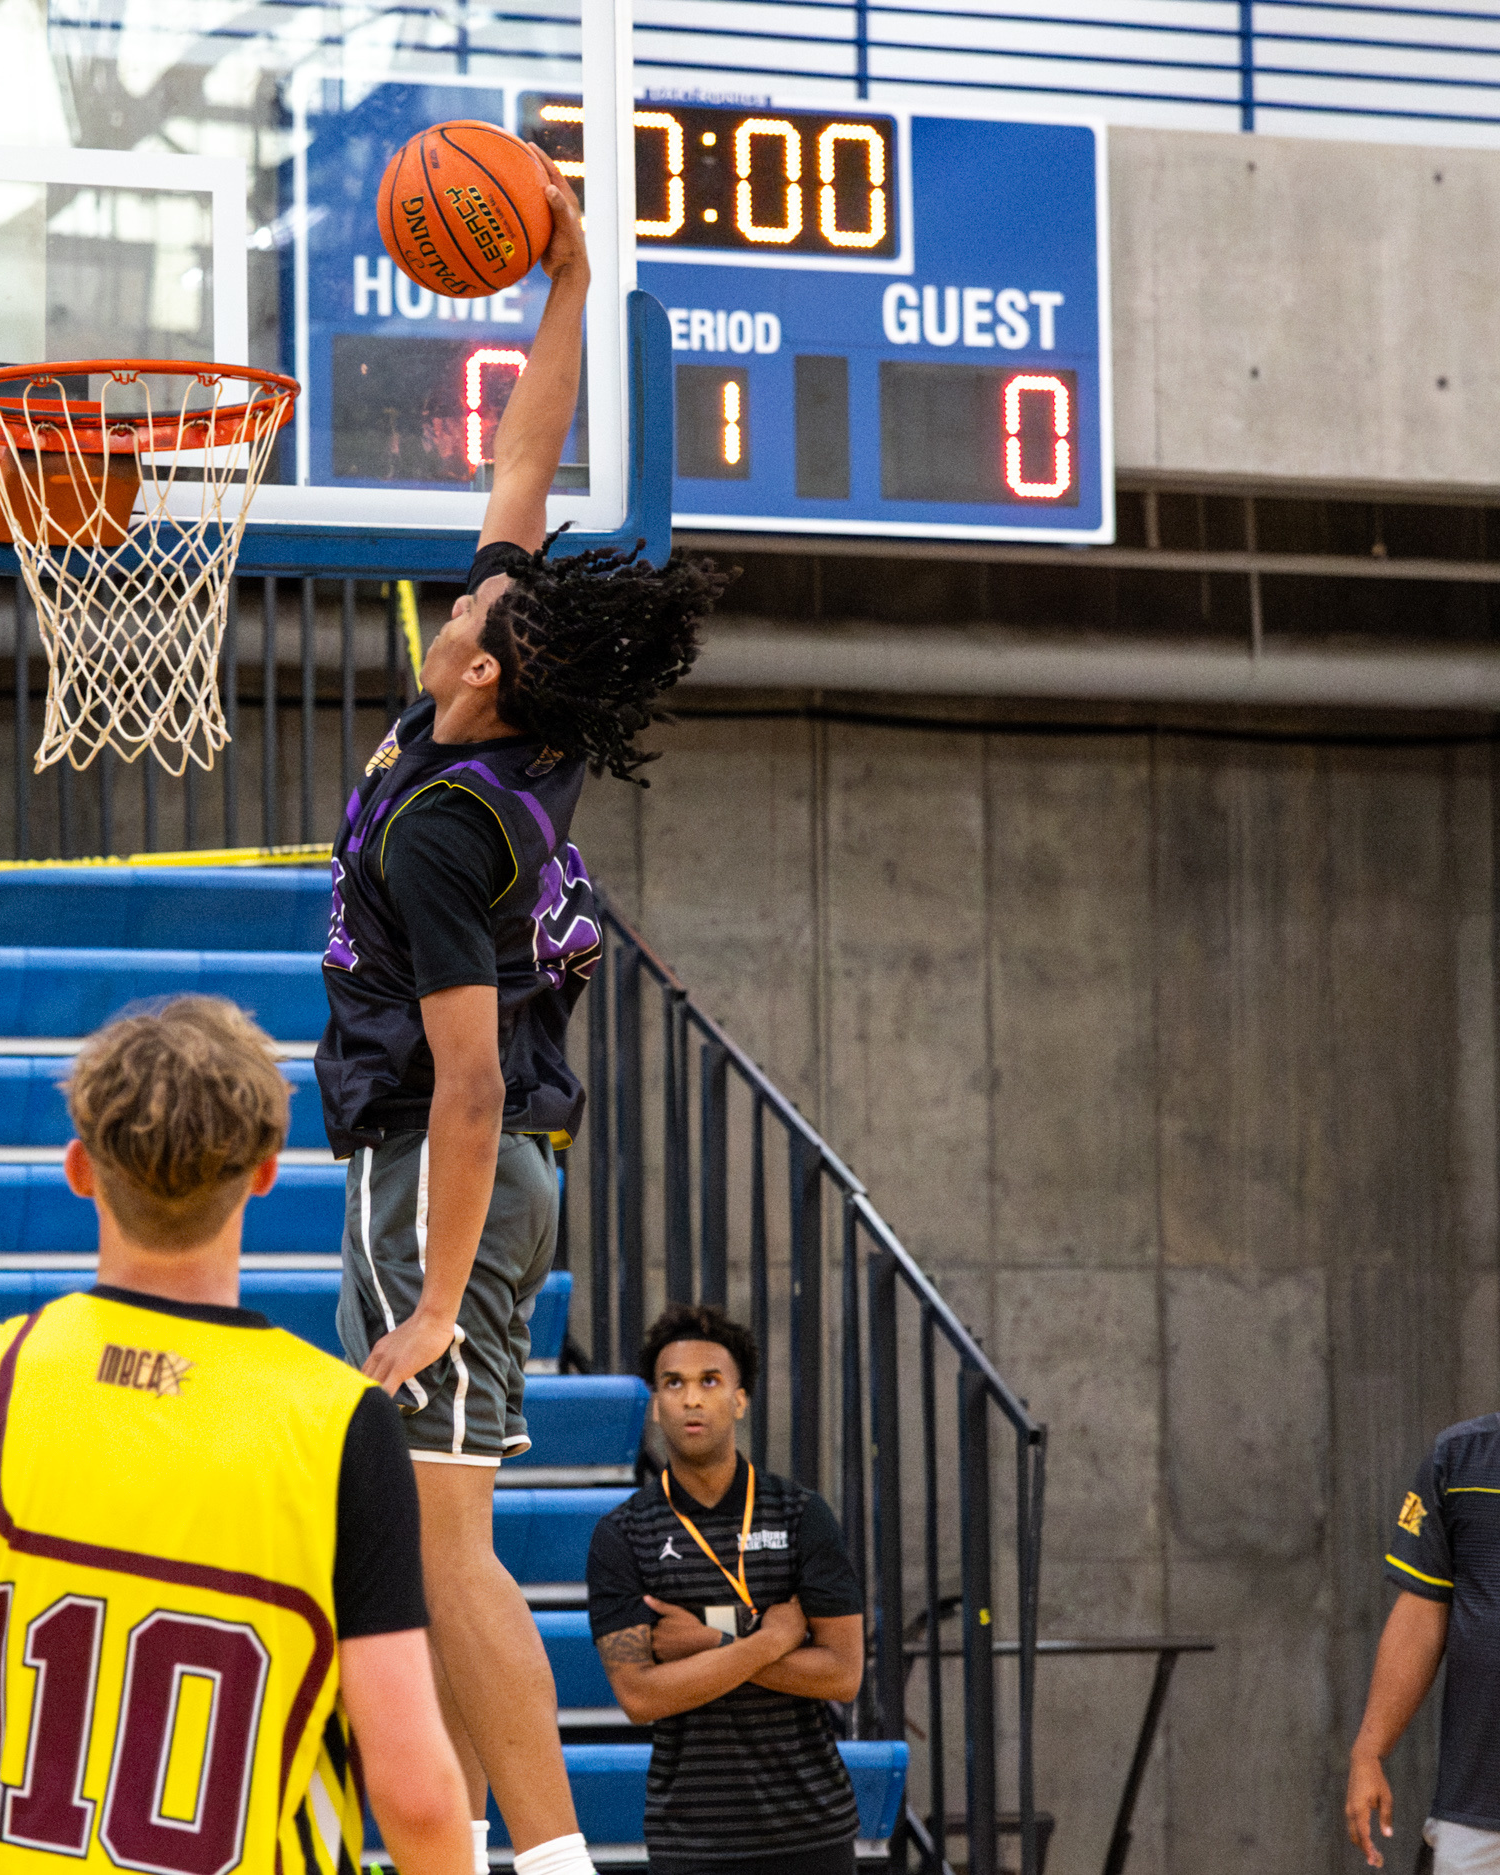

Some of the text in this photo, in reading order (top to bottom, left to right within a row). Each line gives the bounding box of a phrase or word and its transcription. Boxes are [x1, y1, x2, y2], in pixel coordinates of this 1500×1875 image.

[401, 195, 477, 295] SPALDING
[444, 186, 507, 274] LEGACY
[669, 307, 781, 354] ERIOD
[881, 282, 1065, 350] GUEST
[723, 381, 741, 465] 1
[1004, 375, 1071, 499] 0
